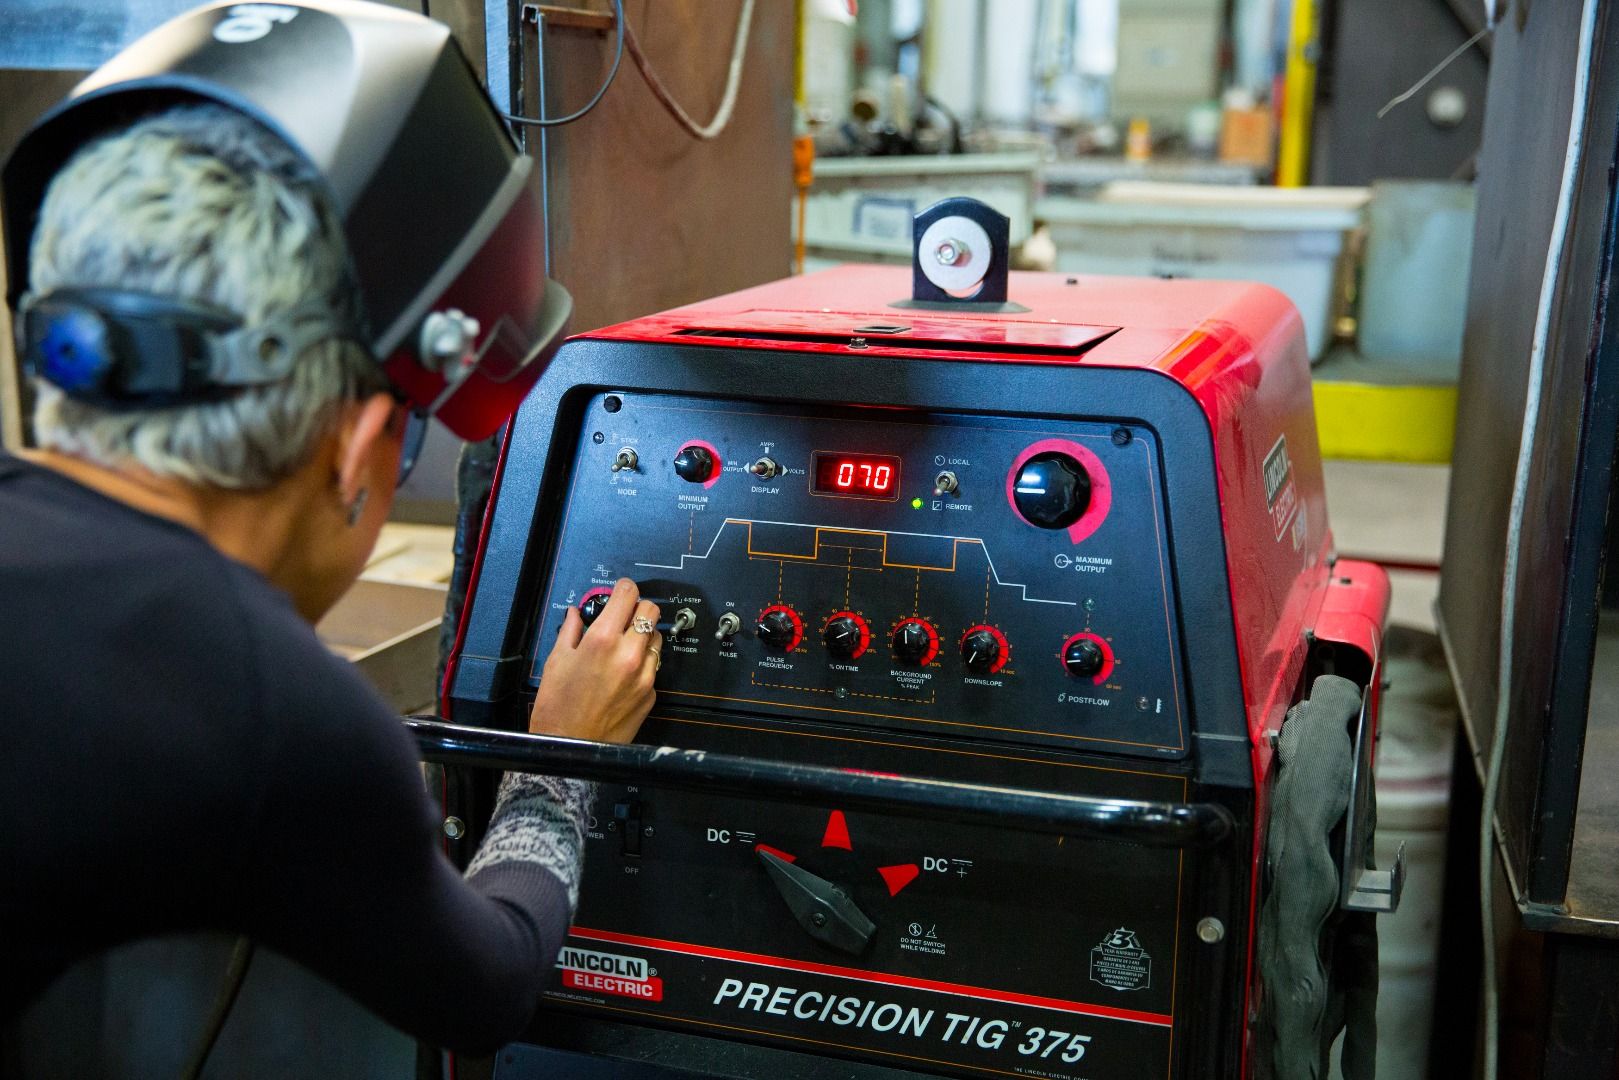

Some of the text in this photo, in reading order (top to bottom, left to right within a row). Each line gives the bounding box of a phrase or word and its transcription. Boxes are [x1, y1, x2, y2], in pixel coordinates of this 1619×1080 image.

[948, 458, 970, 466] LOCAL
[837, 463, 890, 489] 070
[617, 488, 637, 496] MODE
[752, 486, 780, 494] DISPLAY
[679, 494, 708, 502] MINIMUM
[678, 503, 706, 511] OUTPUT
[1076, 556, 1112, 565] MAXIMUM
[1075, 565, 1106, 573] OUTPUT
[759, 661, 794, 669] FREQUENCY
[890, 670, 931, 679] BACKGROUND
[897, 677, 924, 685] CURRENT
[965, 678, 1002, 686] DOWNSLOPE
[1068, 695, 1110, 706] POSTFLOW
[708, 828, 730, 844] DC
[923, 856, 948, 873] DC
[625, 867, 639, 875] OFF
[923, 940, 946, 949] SWITCH
[919, 946, 945, 955] WELDING
[574, 973, 653, 997] ELECTRIC
[713, 978, 934, 1038] PRECISION
[1018, 1026, 1092, 1063] 375
